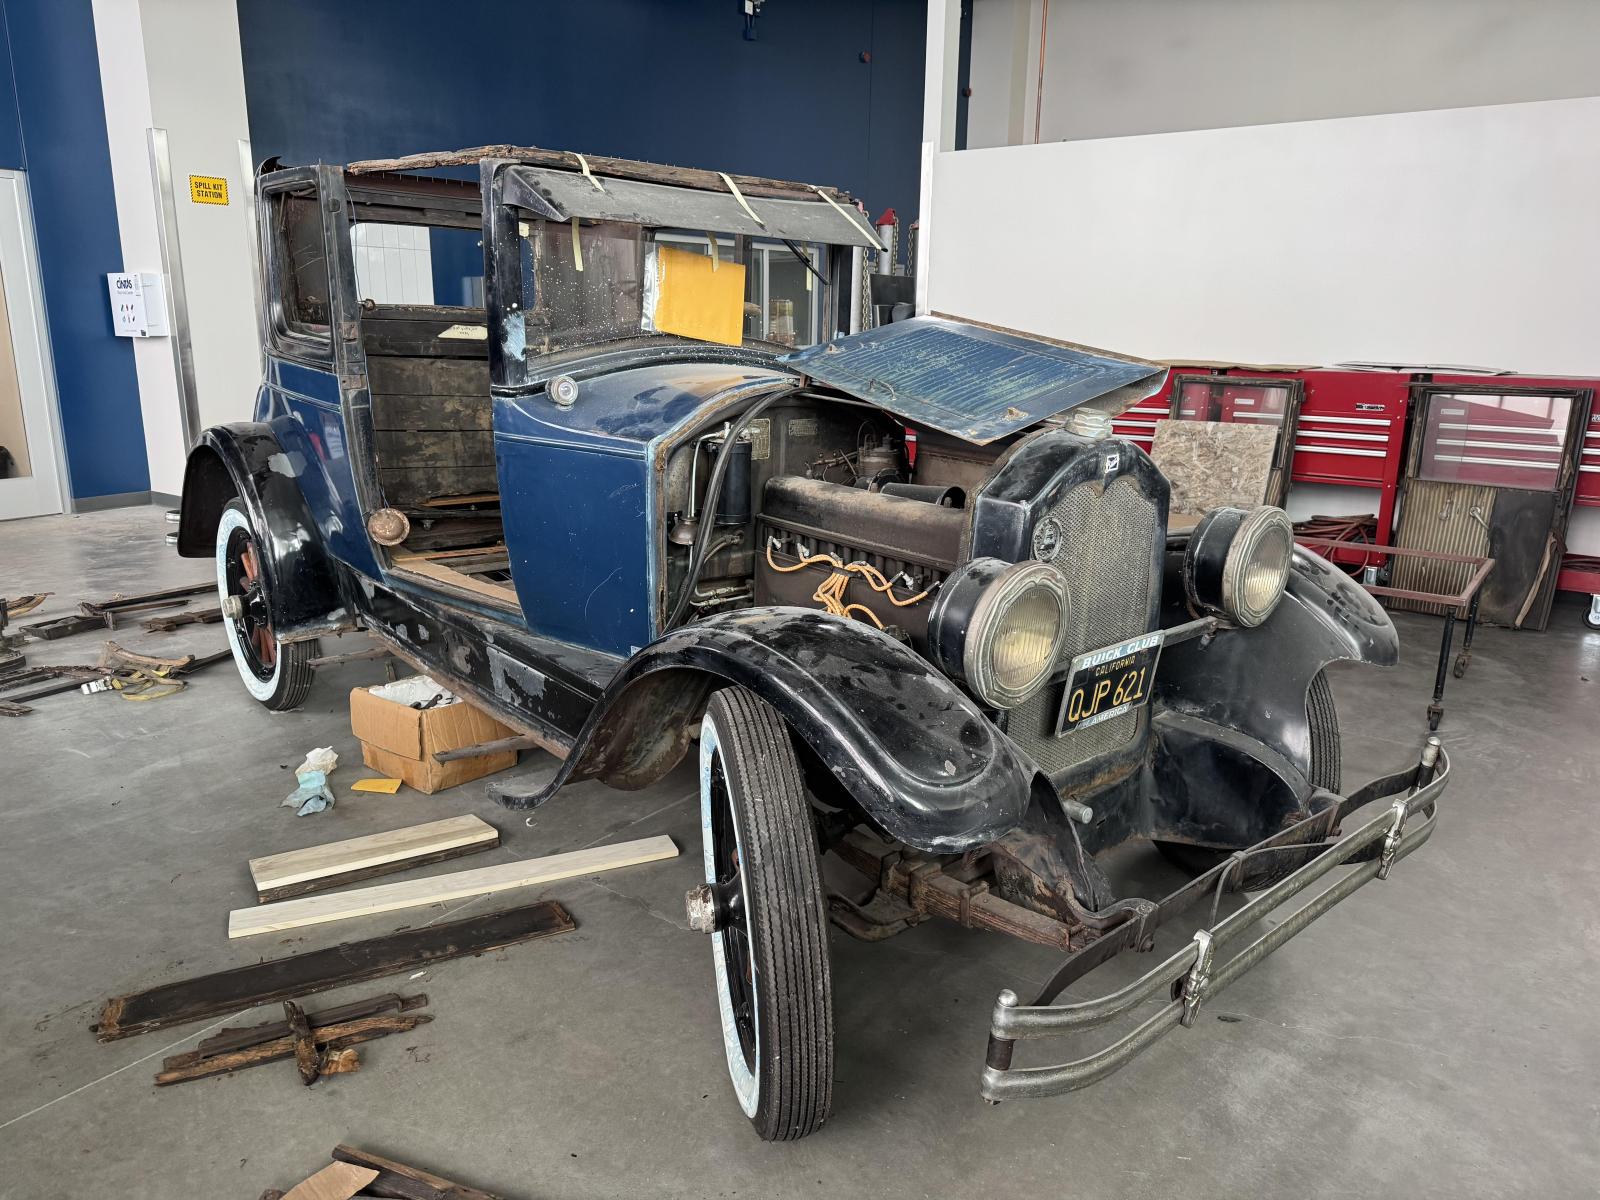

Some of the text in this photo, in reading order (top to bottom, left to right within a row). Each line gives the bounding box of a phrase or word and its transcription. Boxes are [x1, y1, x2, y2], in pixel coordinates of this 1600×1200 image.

[194, 181, 223, 191] SPILL KIT
[196, 190, 223, 199] STATION
[1081, 635, 1160, 671] BUICK CLUB
[1095, 655, 1137, 677] CALIFORNIA
[1068, 666, 1146, 722] QJP 621
[1091, 704, 1129, 725] AMERICA
